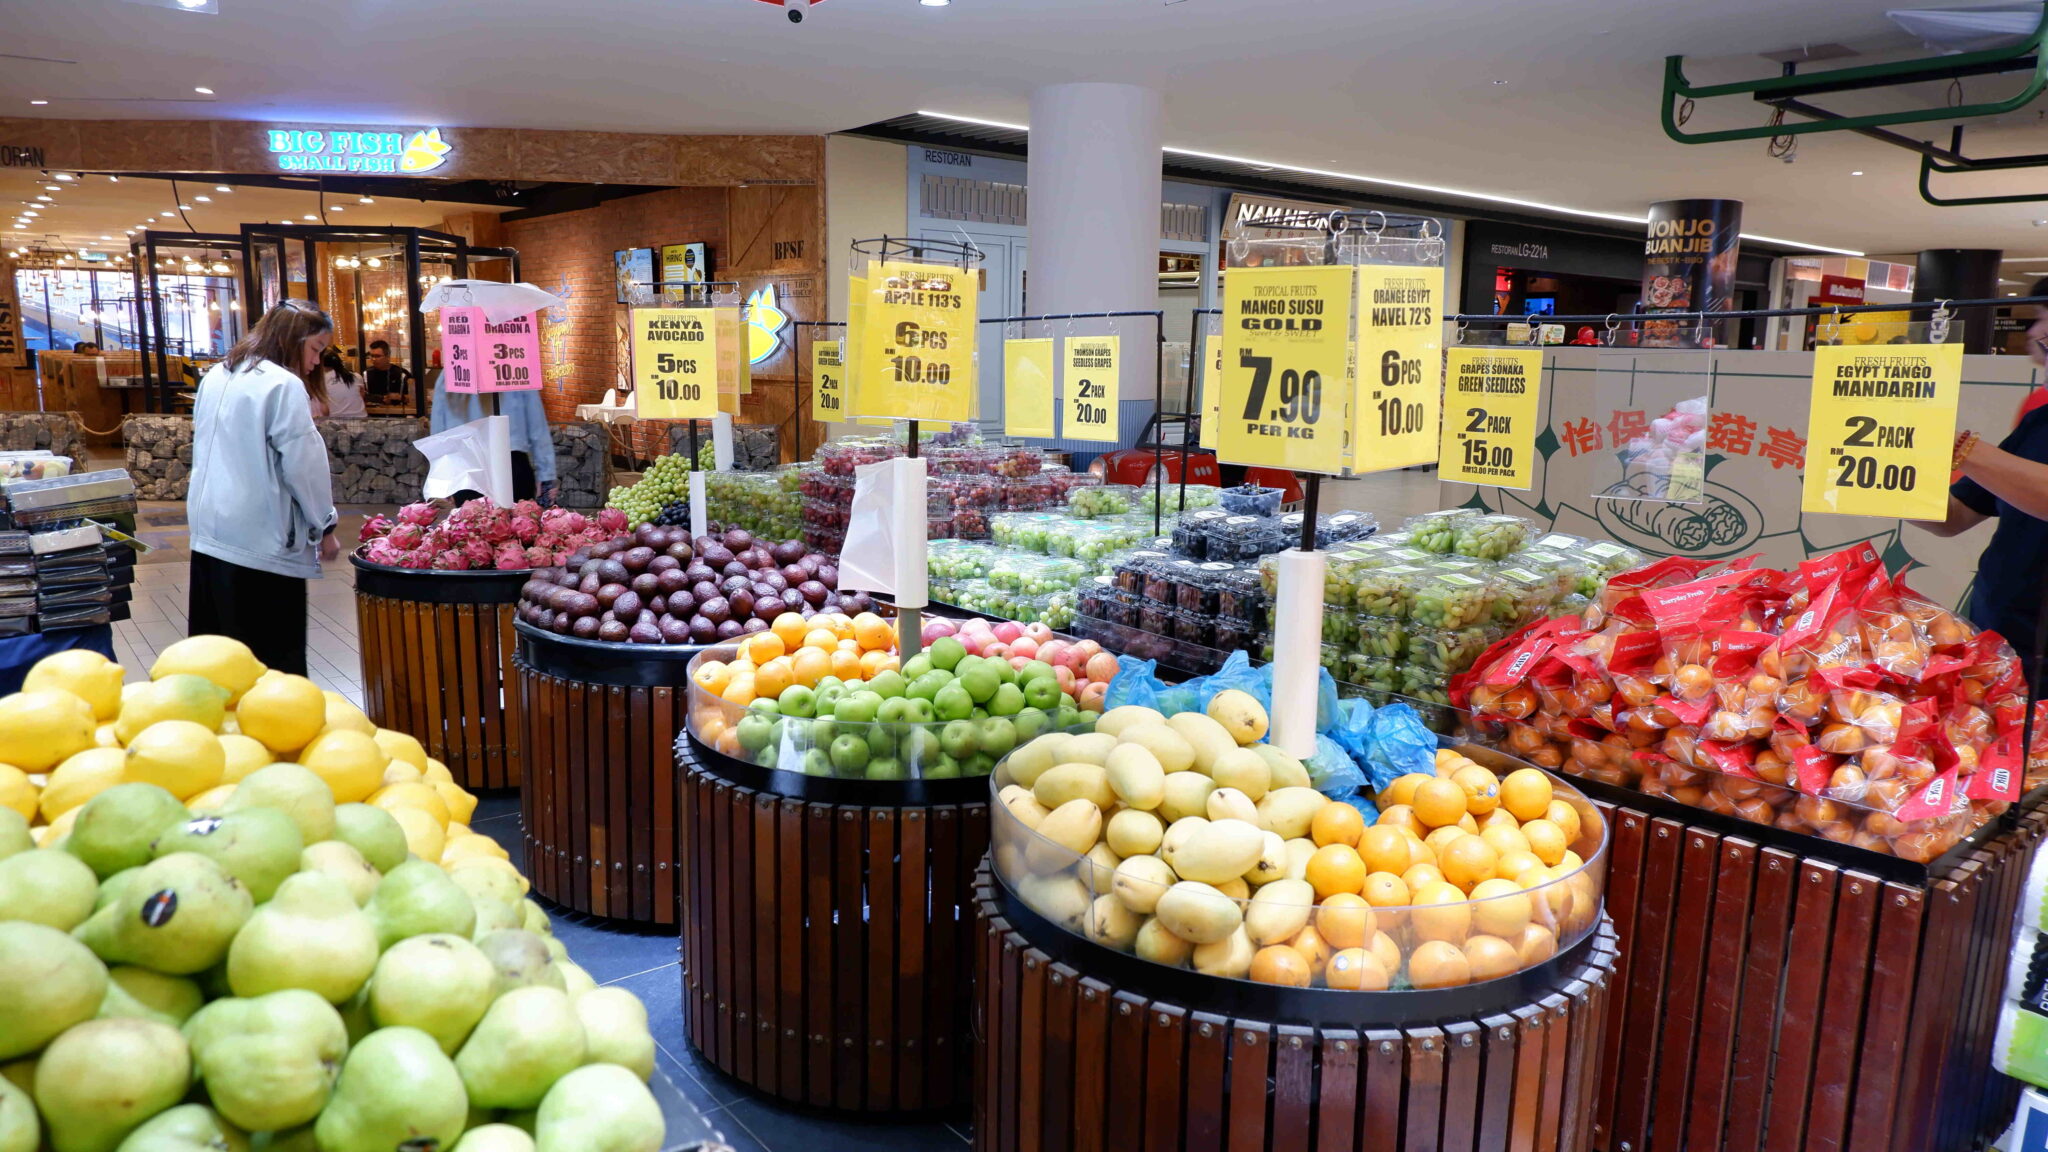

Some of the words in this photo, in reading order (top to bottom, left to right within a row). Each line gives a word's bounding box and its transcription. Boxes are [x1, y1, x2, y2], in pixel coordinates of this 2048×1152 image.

[267, 130, 326, 153] BIG
[330, 131, 404, 155] FISH
[279, 155, 346, 170] SMALL
[348, 157, 396, 172] FISH
[926, 150, 972, 167] RESTORAN
[1237, 203, 1281, 223] NAM
[1648, 220, 1716, 238] WONJO
[1491, 244, 1518, 256] RESTORAN
[1518, 243, 1548, 259] LG-221A
[1646, 238, 1713, 254] BUANJIB
[900, 271, 924, 281] FRESH
[926, 272, 954, 283] FRUITS
[1384, 278, 1404, 289] FRESH
[1405, 278, 1426, 289] FRUITS
[1254, 286, 1288, 296] TROPICAL
[1290, 286, 1317, 296] FRUITS
[1374, 290, 1404, 304] ORANGE
[1408, 290, 1430, 304] EGYPT
[884, 290, 924, 306] APPLE
[928, 294, 961, 309] 113'S
[1242, 300, 1285, 314] MANGO
[1289, 300, 1323, 314] SUSU
[449, 316, 468, 324] RED
[649, 321, 702, 329] KENYA
[1242, 318, 1322, 330] GOLD
[1372, 308, 1406, 326] NAVEL
[1410, 308, 1431, 326] 72'S
[448, 324, 466, 334] DRAGON
[485, 324, 523, 334] DRAGON
[524, 324, 530, 334] A
[648, 330, 704, 341] AVOCADO
[896, 322, 920, 348] 6
[921, 330, 948, 350] PCS
[453, 345, 460, 360] 3
[494, 344, 508, 360] 3
[510, 348, 524, 359] PCS
[1240, 348, 1252, 356] RM
[658, 354, 675, 373] 5
[677, 360, 696, 374] PCS
[1073, 358, 1094, 368] SEEDLESS
[1094, 358, 1112, 368] GRAPES
[1381, 350, 1400, 386] 6
[1401, 359, 1422, 384] PCS
[1472, 357, 1490, 365] FRESH
[1854, 356, 1888, 366] FRESH
[1890, 356, 1926, 366] FRUITS
[453, 365, 470, 382] 10.00
[494, 364, 528, 380] 10.00
[890, 356, 950, 384] 10.00
[1461, 364, 1490, 374] GRAPES
[1492, 365, 1523, 375] SONAKA
[1836, 366, 1880, 378] EGYPT
[1884, 366, 1932, 378] TANGO
[656, 380, 700, 400] 10.00
[822, 374, 830, 389] 2
[830, 379, 838, 390] PACK
[1078, 379, 1091, 398] 2
[1092, 385, 1105, 398] PACK
[1240, 356, 1322, 424] 7.90
[1458, 376, 1484, 392] GREEN
[1486, 377, 1525, 394] SEEDLESS
[1833, 380, 1936, 398] MANDARIN
[821, 393, 840, 410] 20.00
[1076, 403, 1106, 424] 20.00
[1378, 398, 1423, 436] 10.00
[1466, 408, 1487, 432] 2
[1488, 416, 1511, 434] PACK
[1248, 424, 1281, 436] PER
[1288, 427, 1314, 439] KG
[1843, 416, 1878, 447] 2
[1878, 426, 1915, 448] PACK
[1462, 440, 1512, 468] 15.00
[1462, 466, 1486, 474] RM13.00
[1500, 468, 1515, 477] PACK
[1836, 456, 1916, 492] 20.00
[1660, 594, 1687, 606] Everyday
[1688, 590, 1704, 599] Fresh
